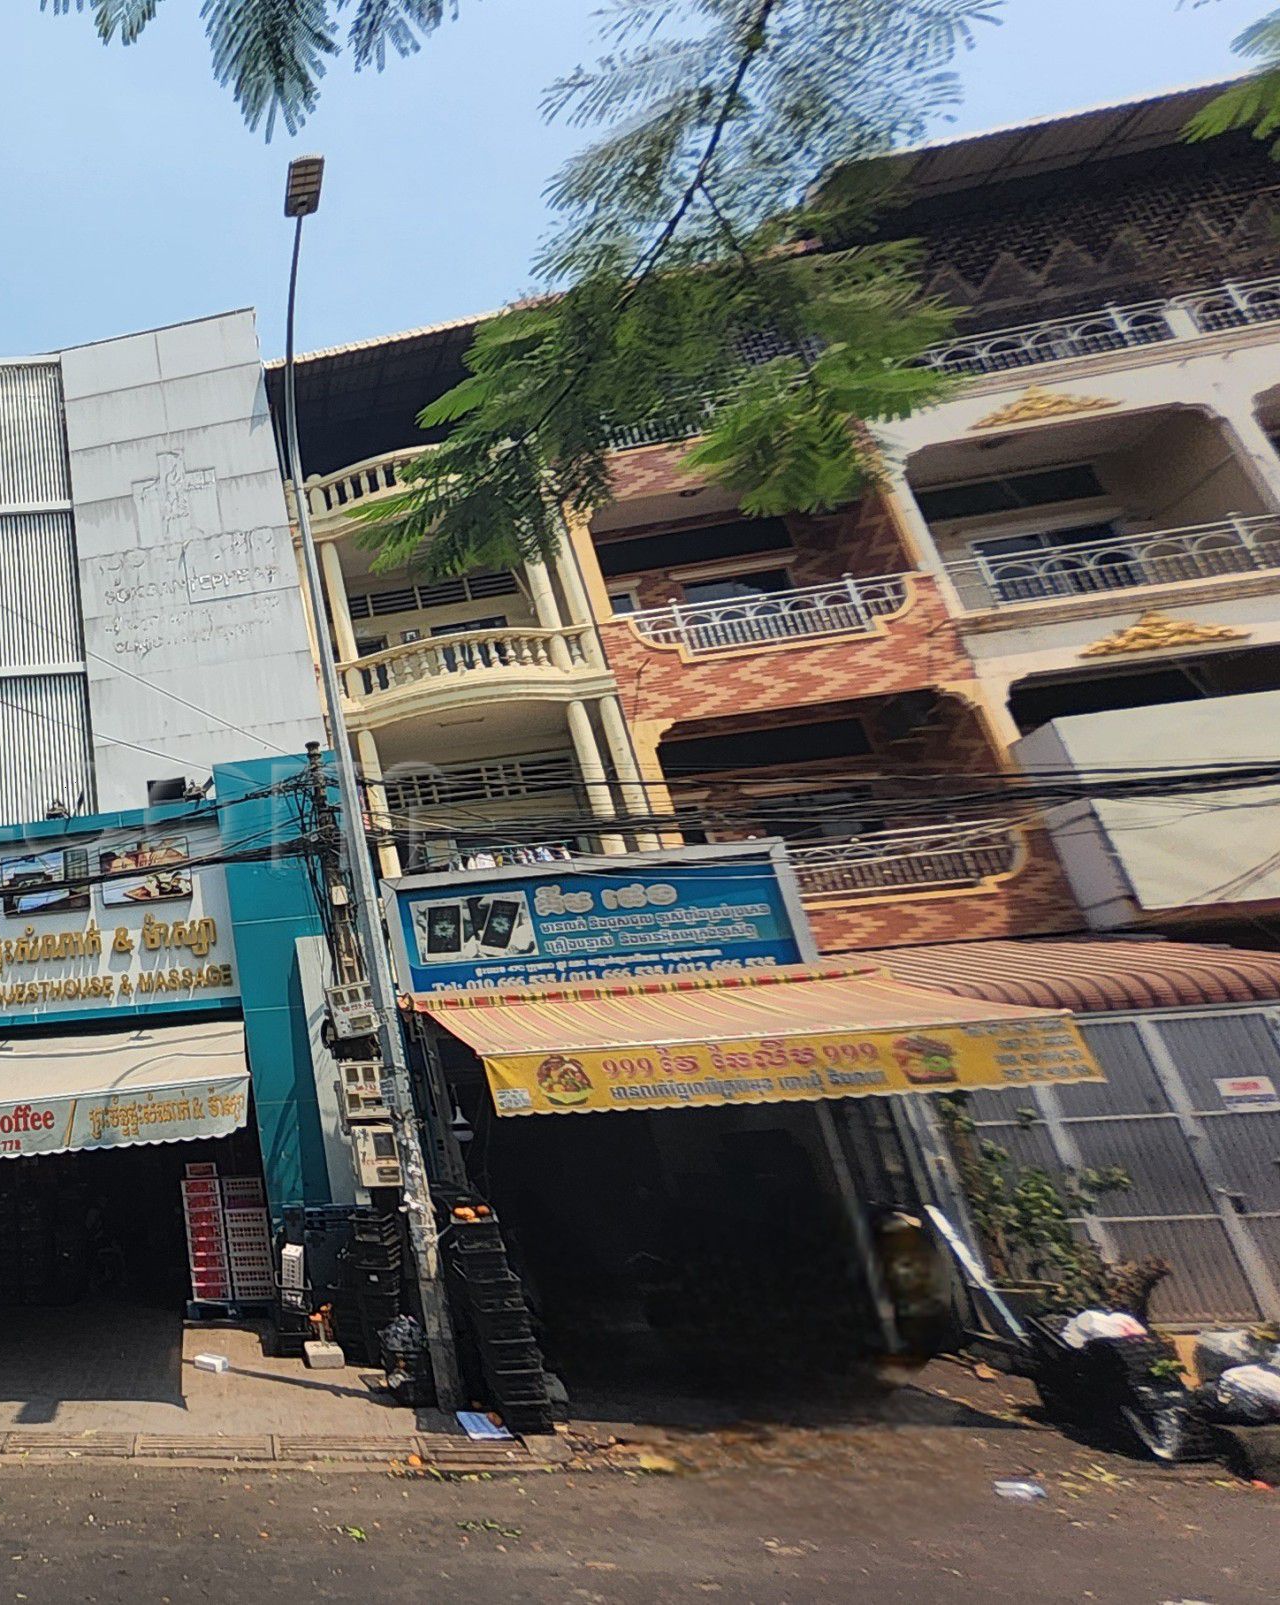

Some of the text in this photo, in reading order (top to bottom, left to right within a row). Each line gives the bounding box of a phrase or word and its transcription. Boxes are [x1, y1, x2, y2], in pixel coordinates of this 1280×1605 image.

[113, 926, 135, 953] &
[120, 974, 133, 995] &
[138, 963, 233, 993] MASSAGE
